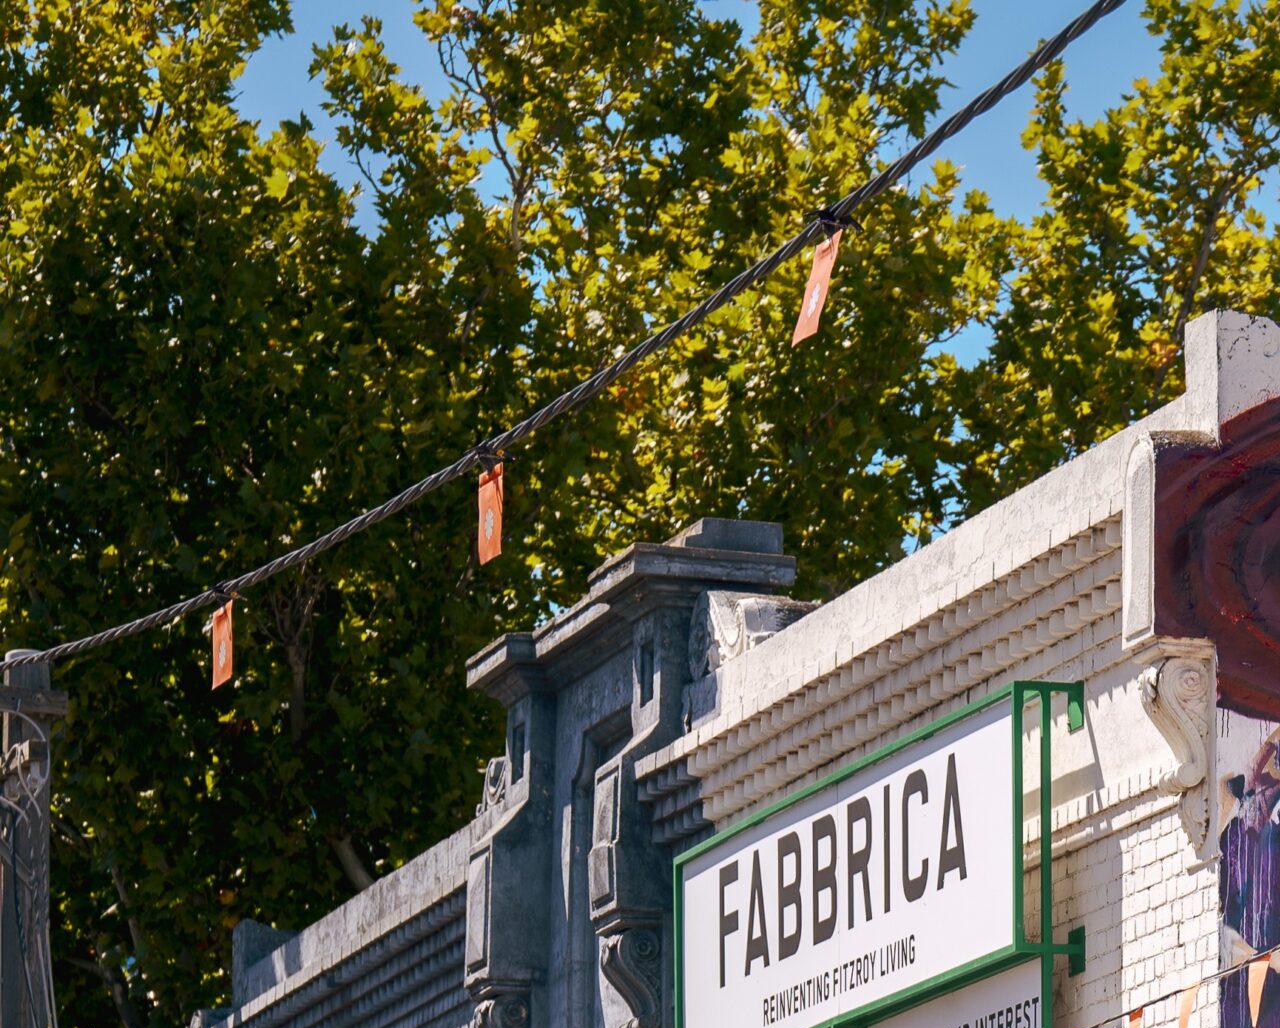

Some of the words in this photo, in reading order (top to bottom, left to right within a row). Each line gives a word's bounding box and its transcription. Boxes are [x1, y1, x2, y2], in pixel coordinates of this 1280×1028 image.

[719, 752, 968, 988] FABBRICA
[763, 971, 830, 1027] REINVENTING
[833, 950, 876, 997] FITZROY
[880, 934, 915, 977] LIVING
